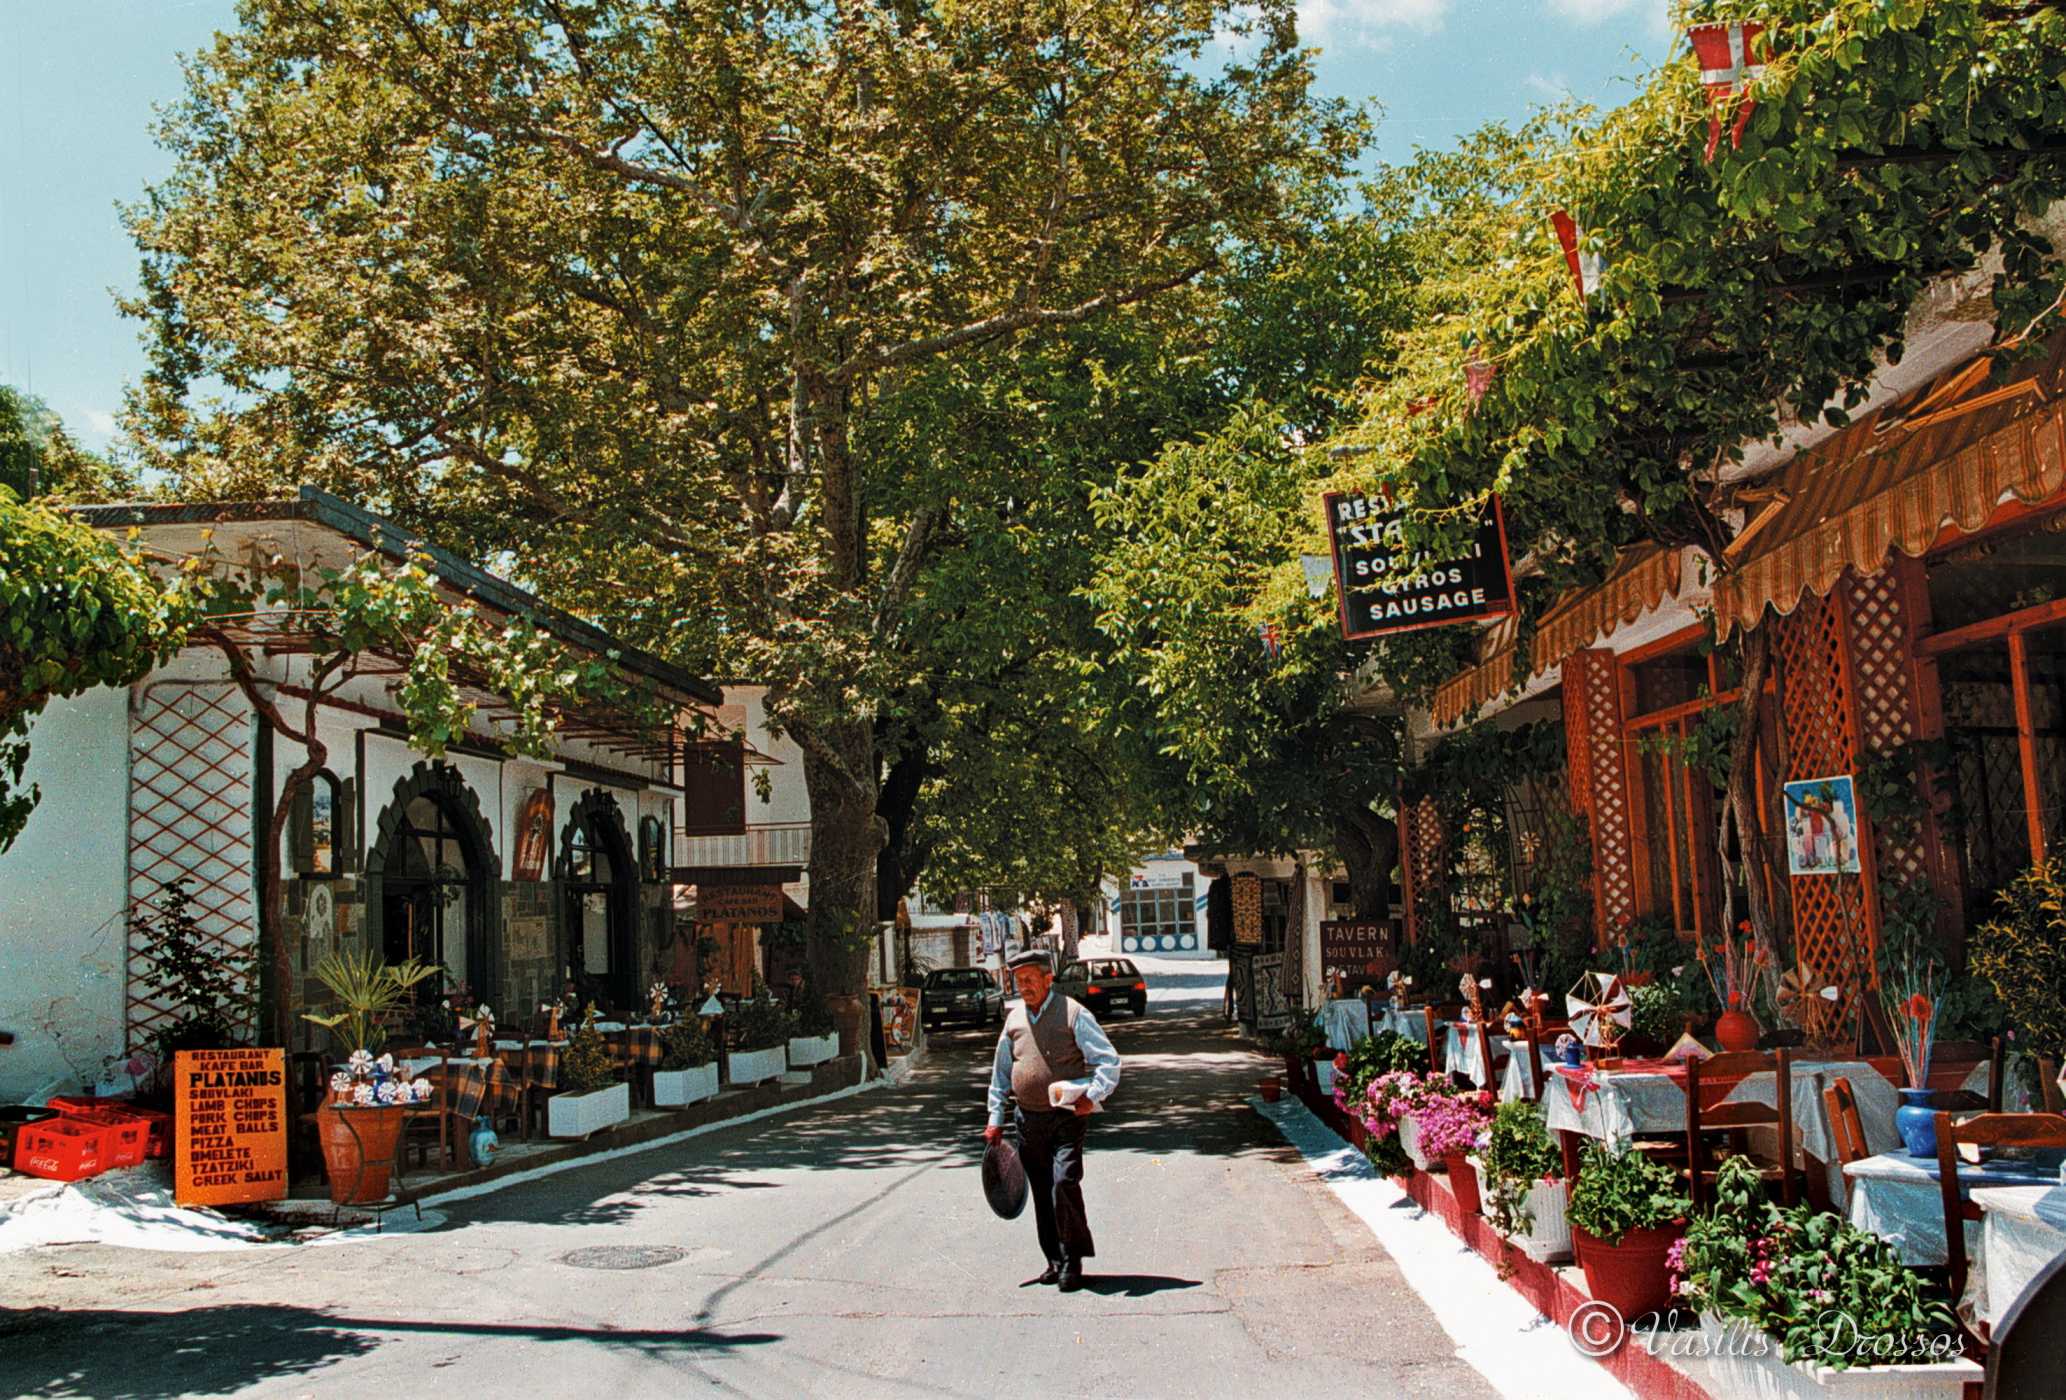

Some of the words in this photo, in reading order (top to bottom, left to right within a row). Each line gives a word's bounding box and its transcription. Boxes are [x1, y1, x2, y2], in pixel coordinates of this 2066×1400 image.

[1370, 588, 1485, 620] SAUSAGE
[702, 906, 778, 919] PLATANOS
[1327, 926, 1389, 941] TAVERN
[192, 1050, 269, 1061] RESTAURANT
[201, 1061, 236, 1071] KAFE
[240, 1060, 264, 1070] BAR
[190, 1071, 281, 1088] PLATANOS
[190, 1088, 253, 1100] SOUVLAKI
[191, 1100, 225, 1112] LAMB
[234, 1098, 277, 1110] CHOPS
[191, 1112, 226, 1124] PORK
[234, 1110, 277, 1122] CHOPS
[191, 1124, 226, 1136] MEAT
[236, 1122, 278, 1134] BALLS
[191, 1136, 233, 1149] PIZZA
[191, 1147, 251, 1162] OMELETE
[191, 1159, 254, 1174] TZATZIKI
[245, 1169, 283, 1183] SALAT
